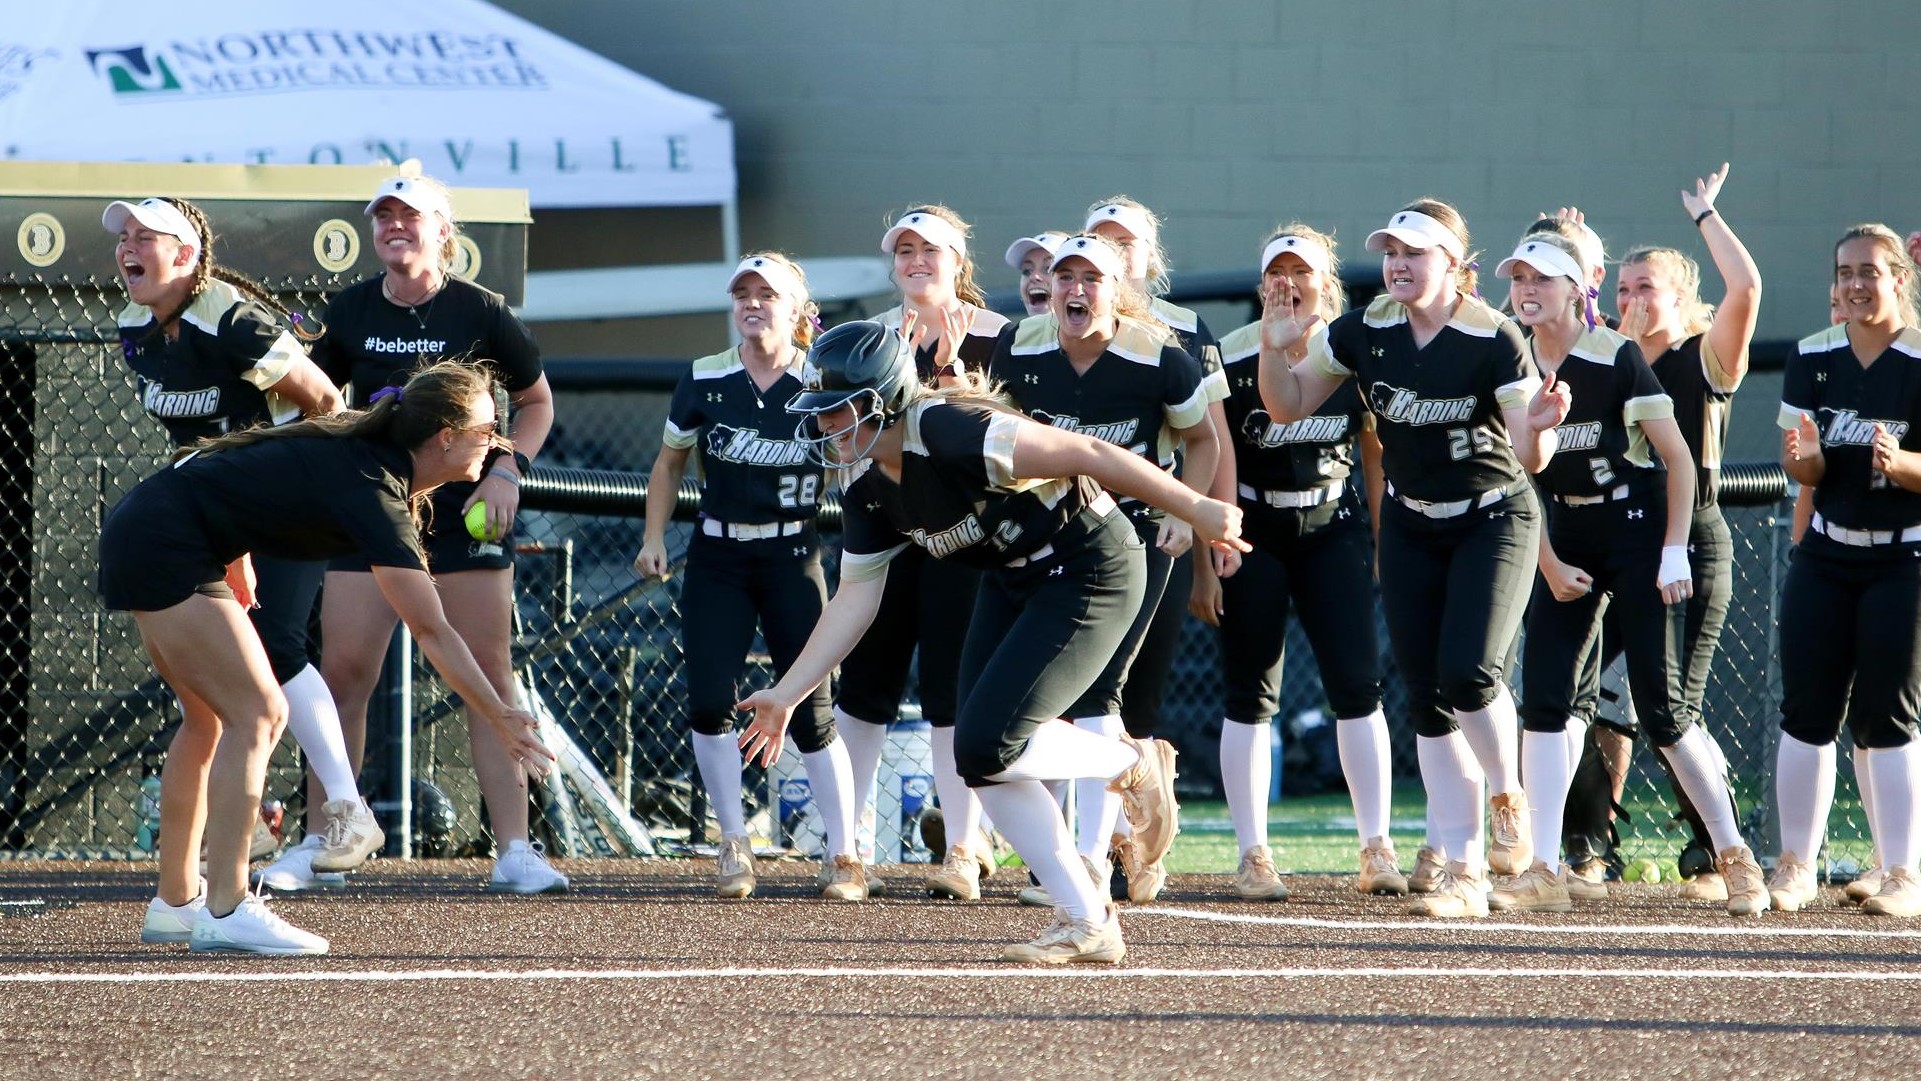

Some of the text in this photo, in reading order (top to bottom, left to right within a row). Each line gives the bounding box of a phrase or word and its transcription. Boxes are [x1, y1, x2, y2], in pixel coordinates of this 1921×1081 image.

[168, 31, 520, 64] NORTHWEST
[188, 62, 549, 90] MEDICAL CENTER
[31, 224, 51, 255] B
[327, 230, 347, 261] B
[364, 336, 446, 353] #bebetter
[144, 381, 220, 418] HARDING
[1385, 387, 1477, 427] HARDING
[1446, 425, 1494, 461] 29
[1588, 457, 1616, 487] 2
[777, 474, 819, 508] 28
